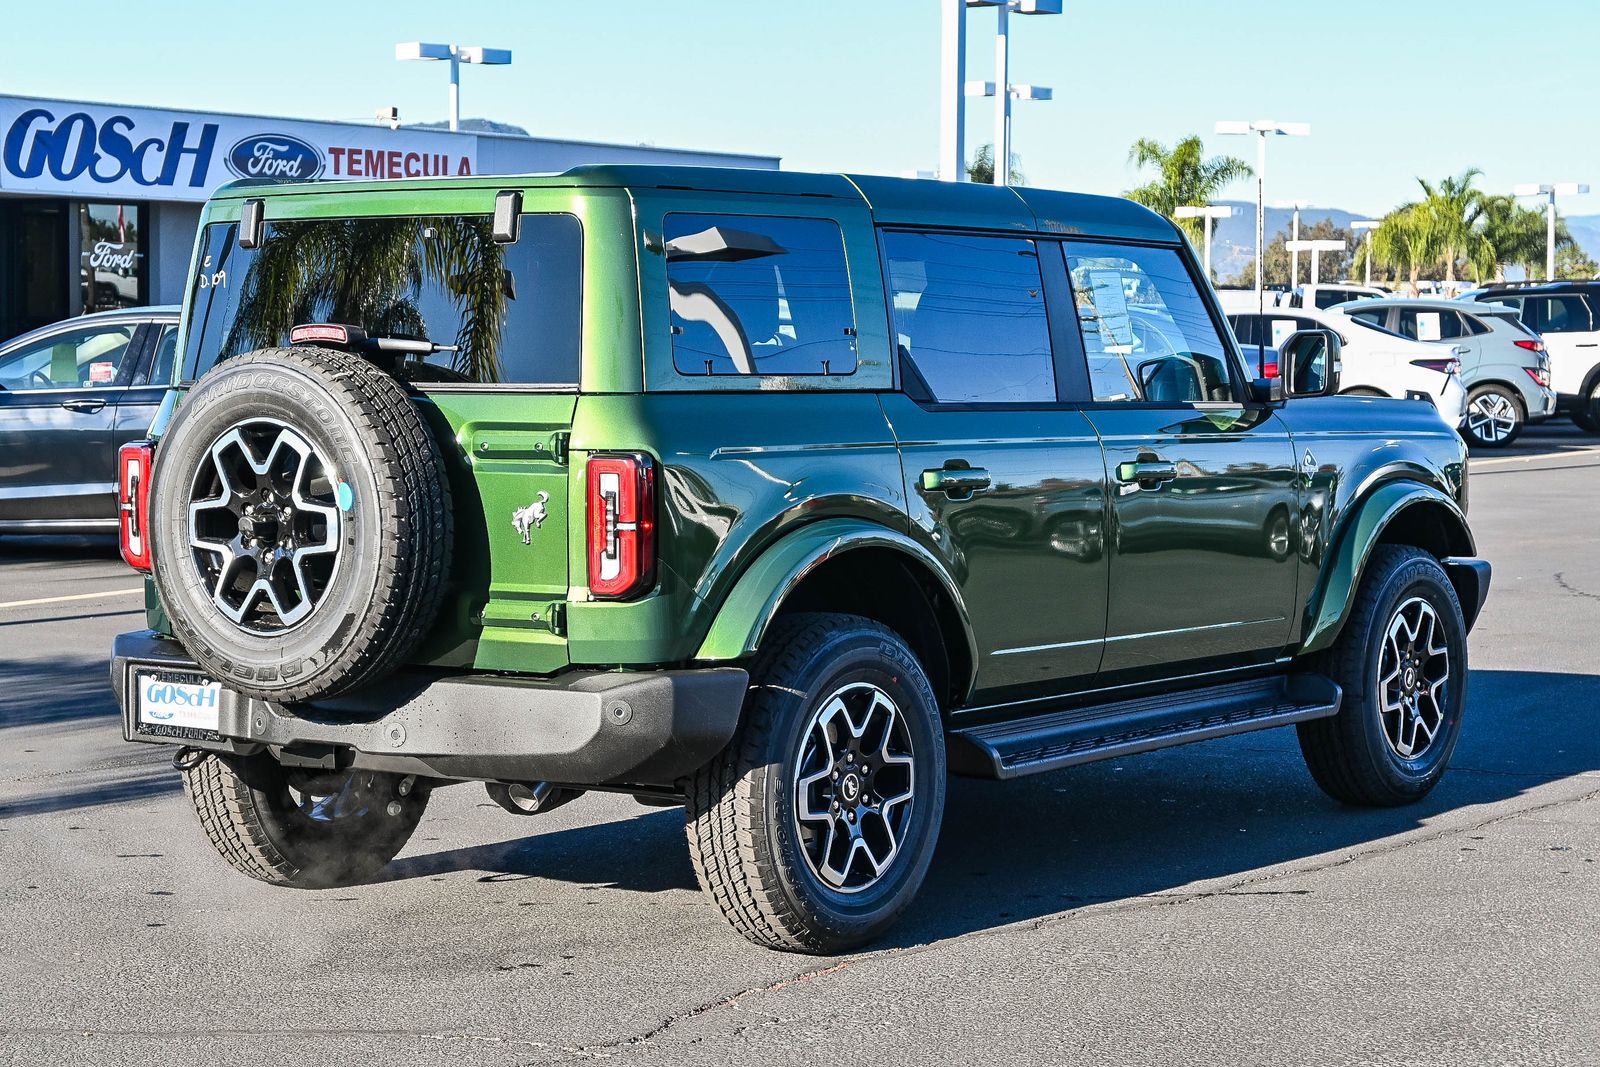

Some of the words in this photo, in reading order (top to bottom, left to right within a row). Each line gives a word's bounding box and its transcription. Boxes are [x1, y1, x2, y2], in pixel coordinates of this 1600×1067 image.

[247, 141, 302, 177] Ford
[328, 146, 472, 179] TEMECULA
[90, 241, 134, 268] Ford
[191, 372, 359, 464] BRIDGESTONE
[178, 618, 303, 682] DUELER
[155, 671, 202, 684] TEMECULA
